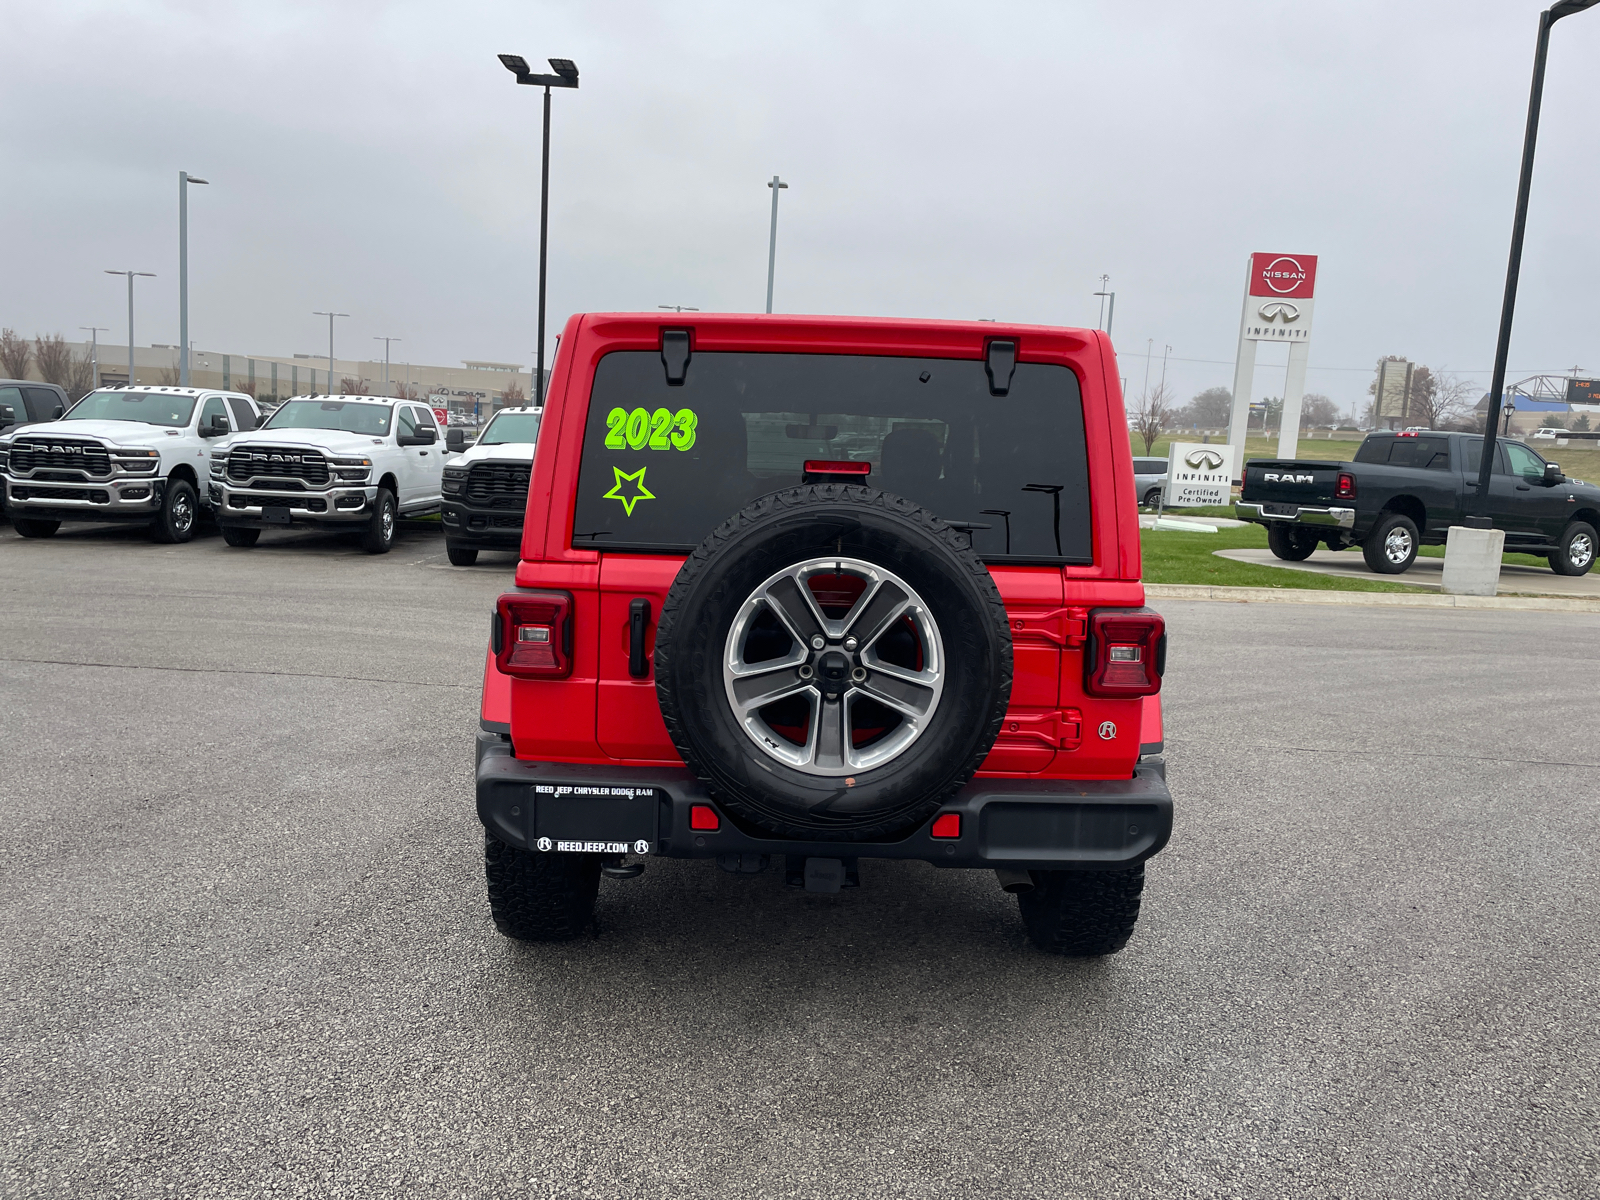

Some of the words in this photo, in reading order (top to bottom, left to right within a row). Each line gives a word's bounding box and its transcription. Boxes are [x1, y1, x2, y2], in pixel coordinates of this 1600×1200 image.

[1262, 271, 1306, 279] NISSAN
[1247, 327, 1307, 337] INFINITI
[605, 407, 698, 451] 2023
[33, 445, 81, 453] RAM
[253, 453, 300, 463] RAM
[1176, 473, 1228, 482] INFINITI
[1264, 473, 1314, 484] RAM
[1183, 488, 1219, 497] Certified
[1178, 495, 1222, 504] Pre-Owned
[536, 785, 554, 794] REED
[556, 786, 573, 795] JEEP
[574, 787, 610, 796] CHRYSLER
[611, 788, 635, 796] DODGE
[636, 788, 653, 796] RAM
[557, 841, 628, 853] REEDJEEP.COM
